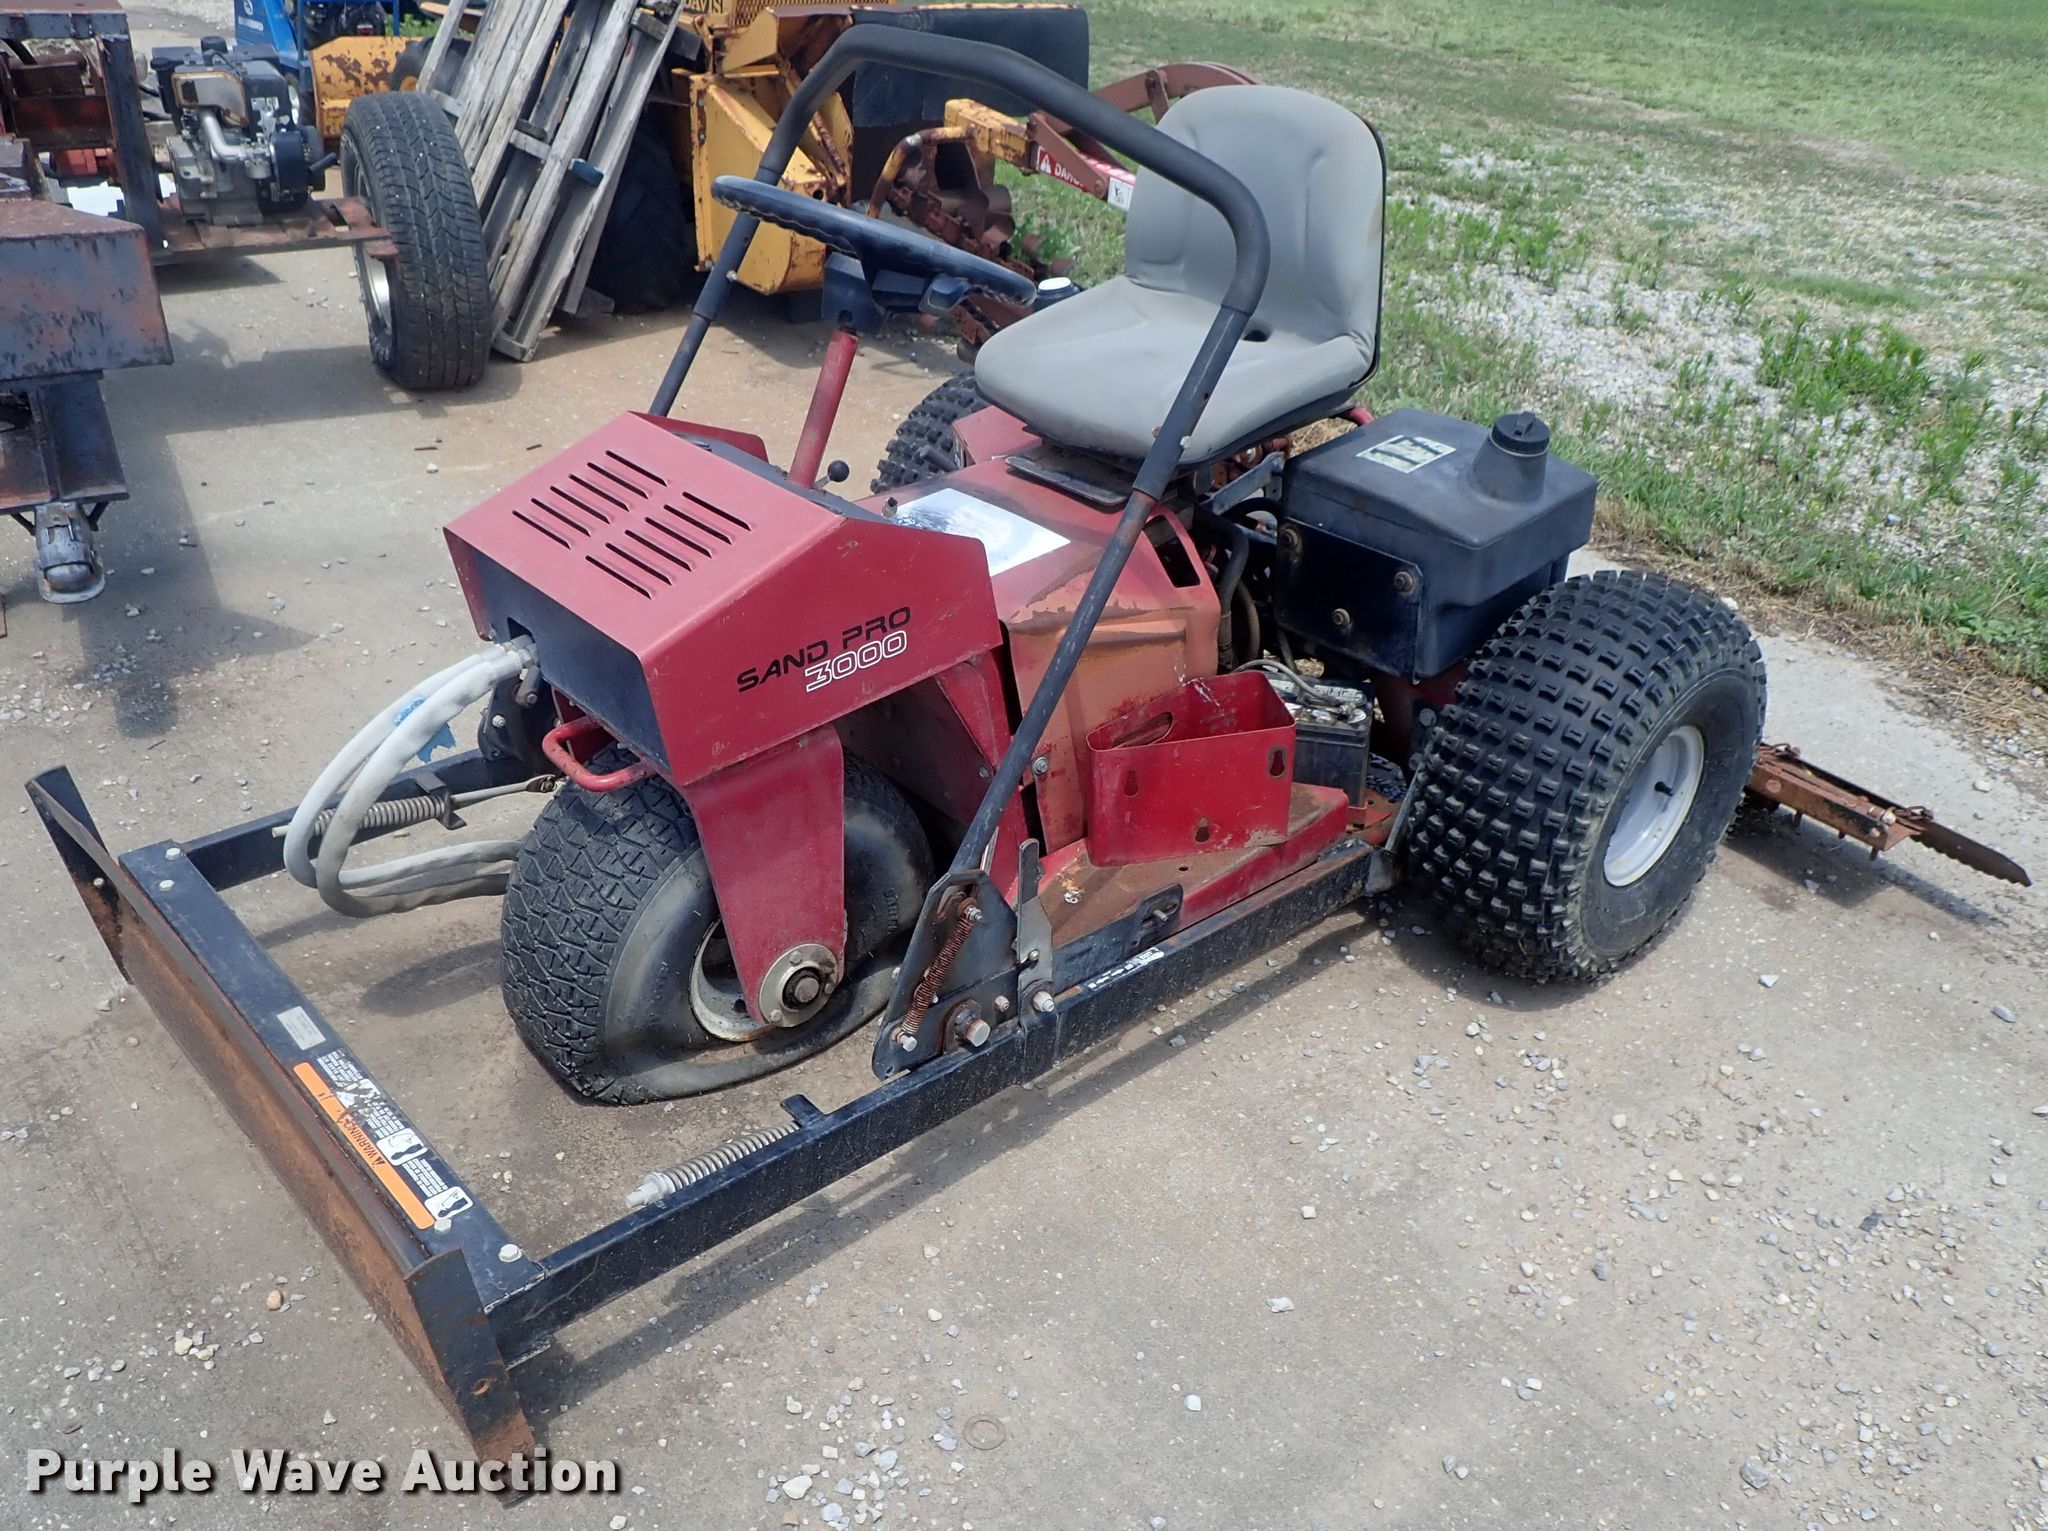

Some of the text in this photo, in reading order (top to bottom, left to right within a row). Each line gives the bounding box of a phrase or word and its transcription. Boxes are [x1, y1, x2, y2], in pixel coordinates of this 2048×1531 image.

[737, 606, 911, 693] SAND PRO
[804, 630, 908, 693] 3000
